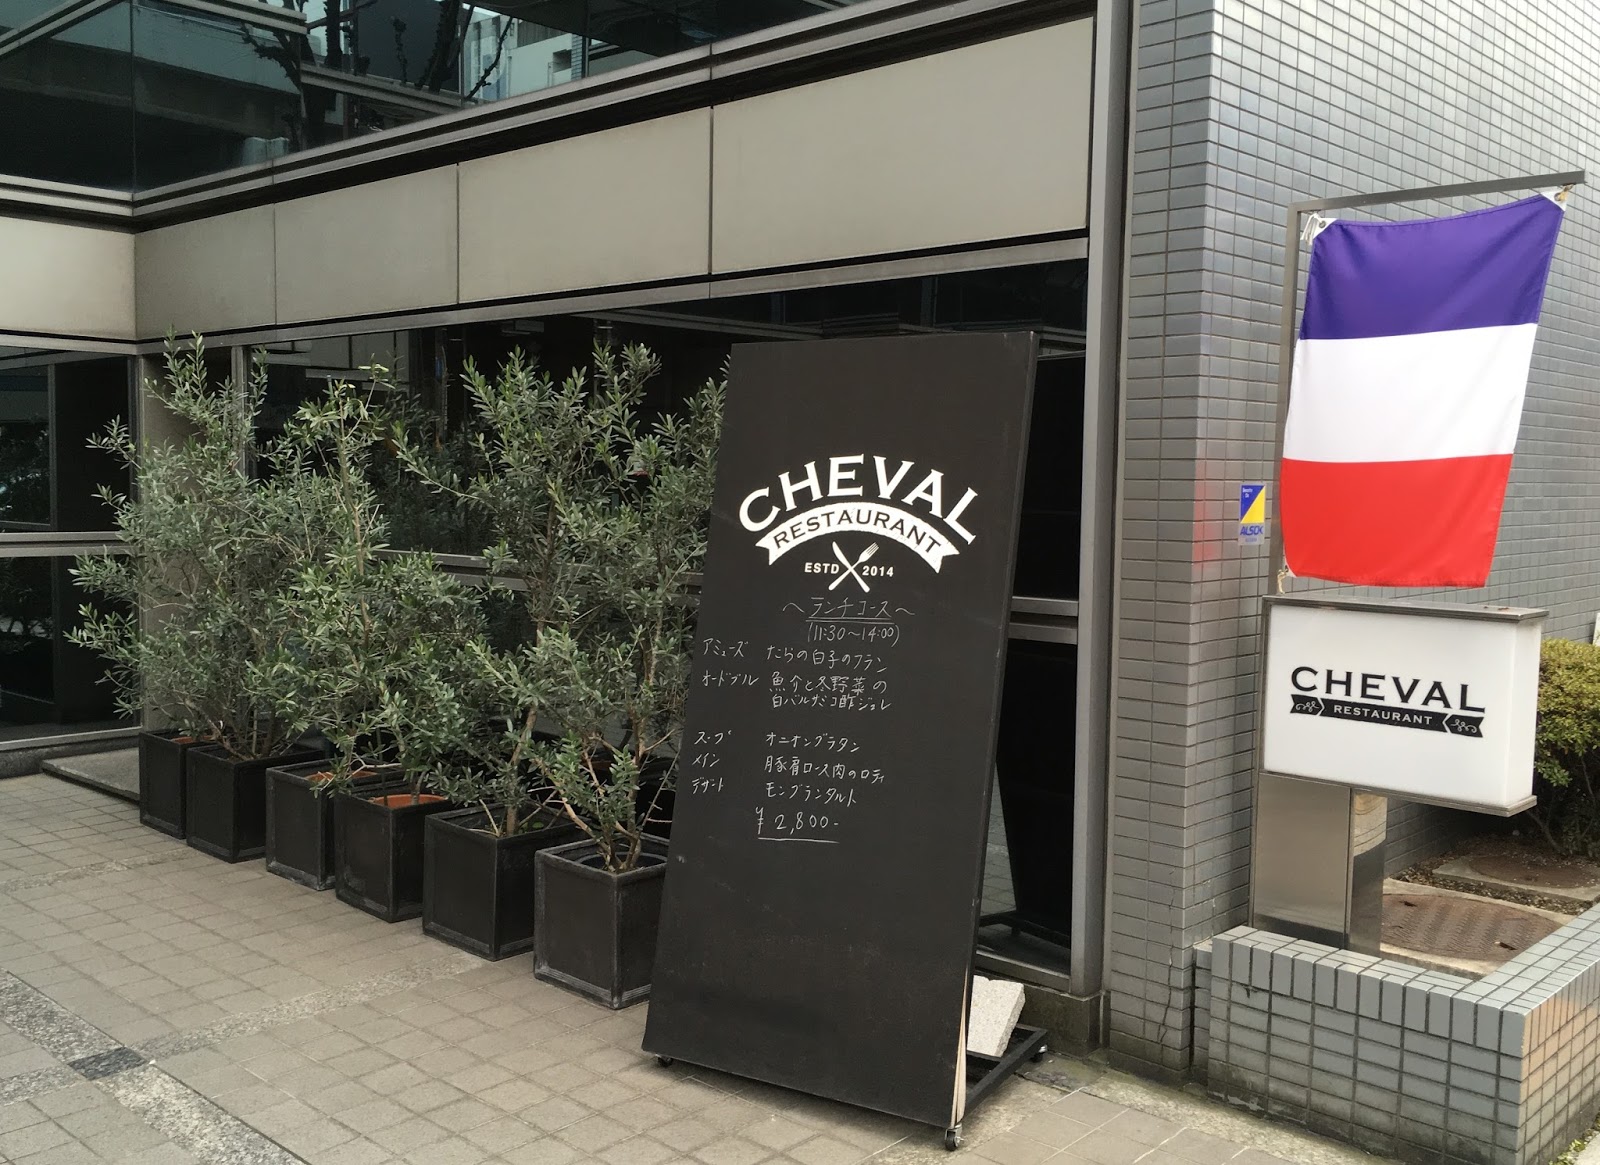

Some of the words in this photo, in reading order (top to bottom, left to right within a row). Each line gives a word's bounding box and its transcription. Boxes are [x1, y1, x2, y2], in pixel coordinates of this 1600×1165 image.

[739, 454, 978, 545] CHEVAL
[772, 508, 942, 553] RESTAURANT
[1240, 525, 1264, 536] ALSOK
[804, 562, 840, 574] ESTD
[862, 565, 894, 577] 2014
[703, 637, 749, 658] アミューズ
[767, 645, 888, 673] たらの白子のフラン
[702, 669, 760, 687] オードブル
[769, 671, 888, 696] 魚介と冬野菜の
[1291, 666, 1486, 714] CHEVAL
[1333, 704, 1433, 725] RESTAURANT
[766, 731, 861, 753] オニオングラタン
[692, 752, 721, 768] メイン
[766, 781, 857, 808] モンブランタルト
